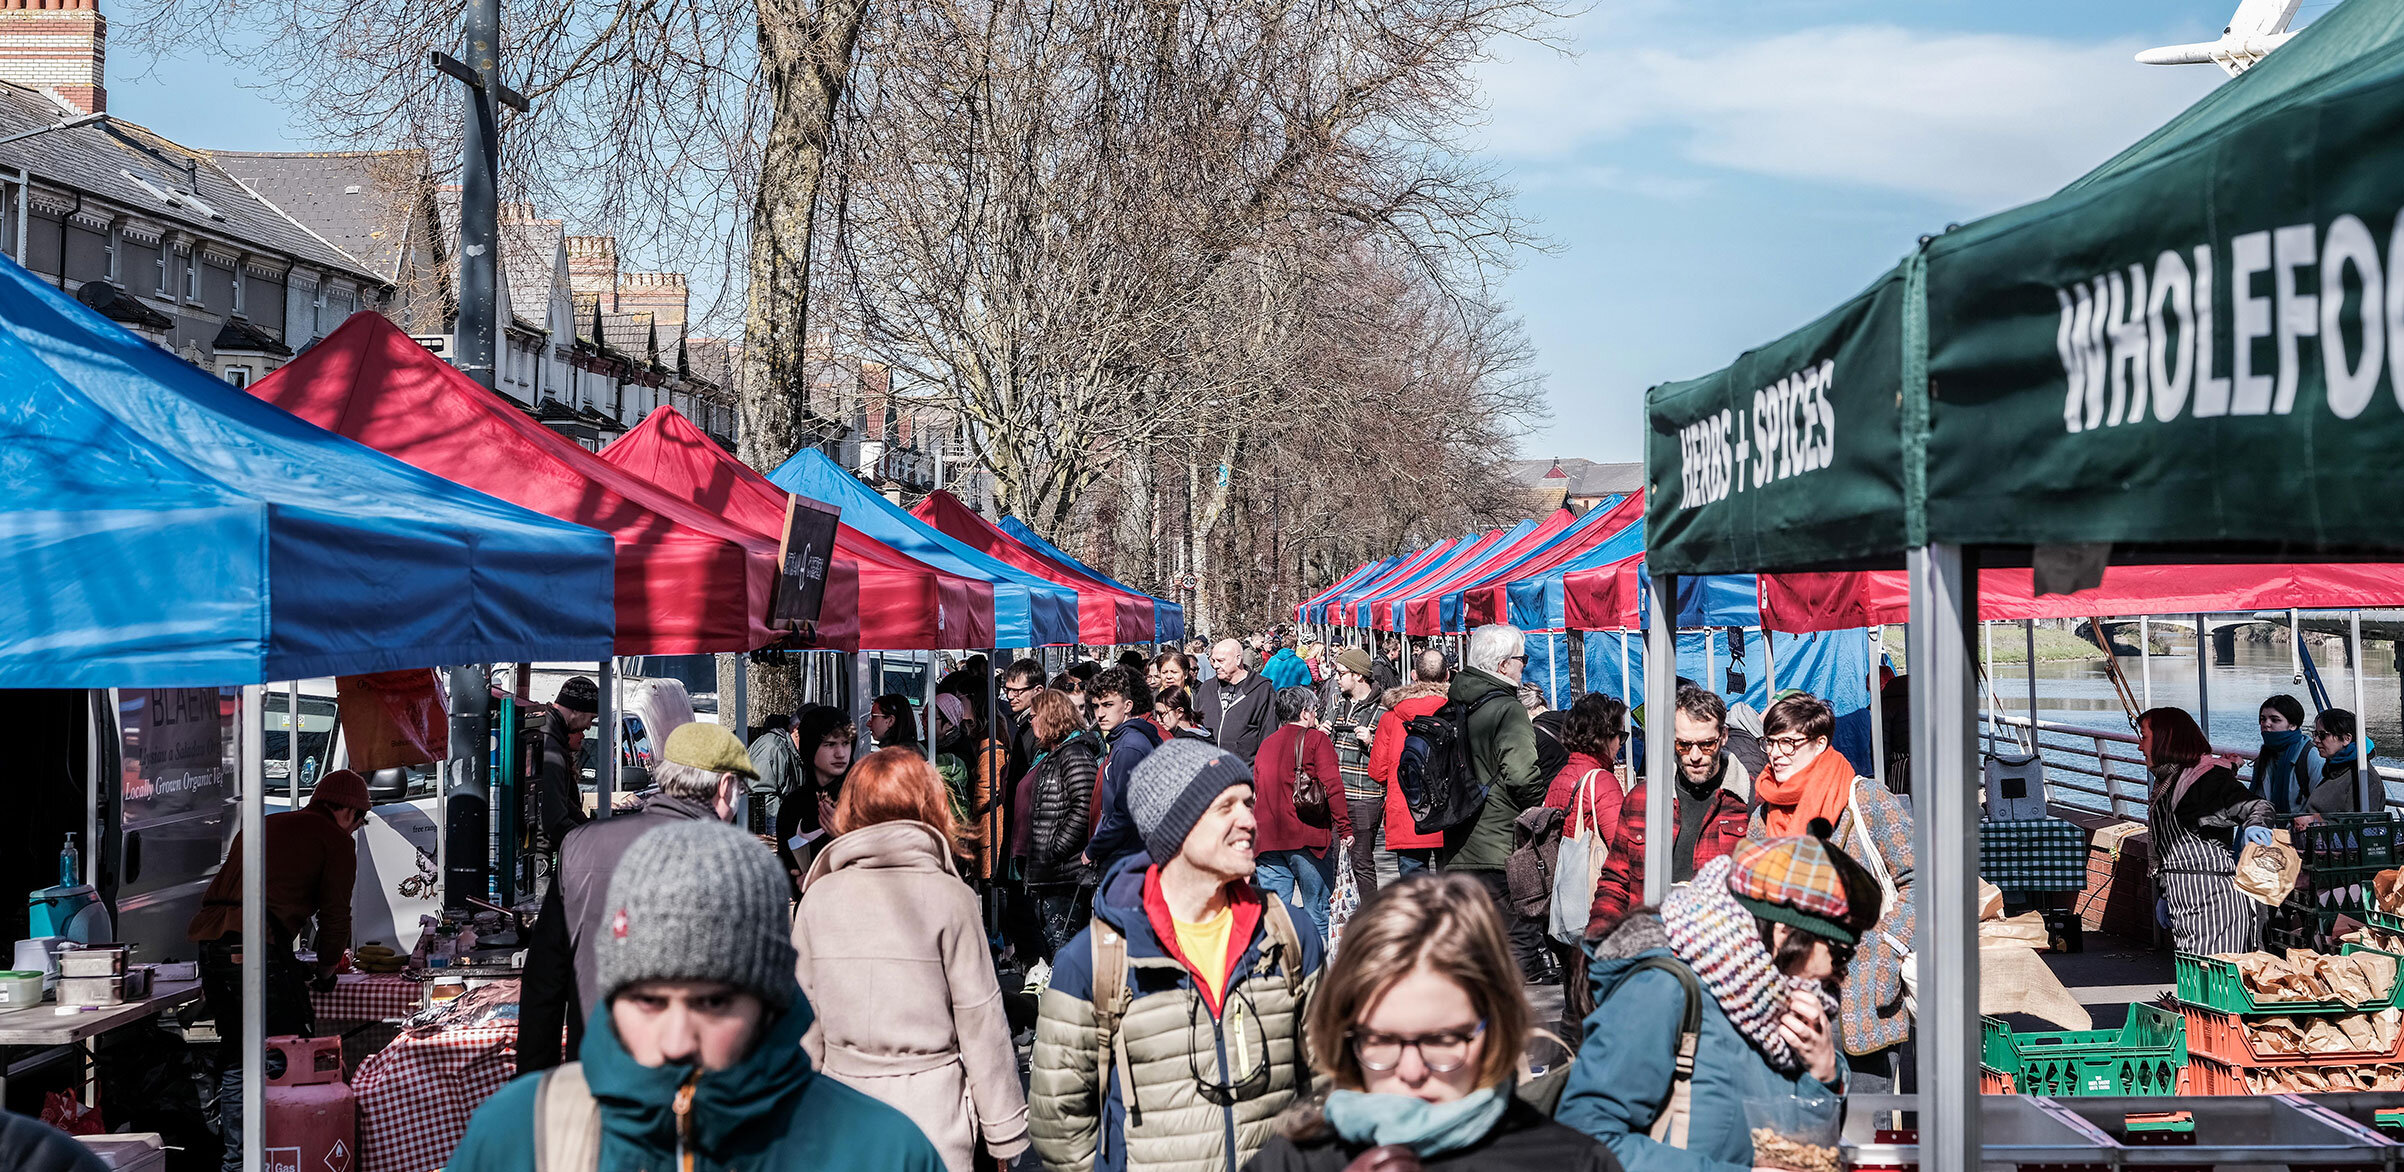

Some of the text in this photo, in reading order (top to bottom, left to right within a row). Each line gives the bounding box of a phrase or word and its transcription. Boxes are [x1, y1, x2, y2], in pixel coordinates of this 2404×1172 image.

[2056, 205, 2404, 433] WHOLEFO
[1679, 358, 1835, 511] HERBS + SPICES
[125, 779, 155, 801] Locally
[155, 776, 181, 795] Grown
[183, 770, 213, 793] Organic
[424, 825, 438, 833] rang
[275, 1162, 296, 1172] Gas
